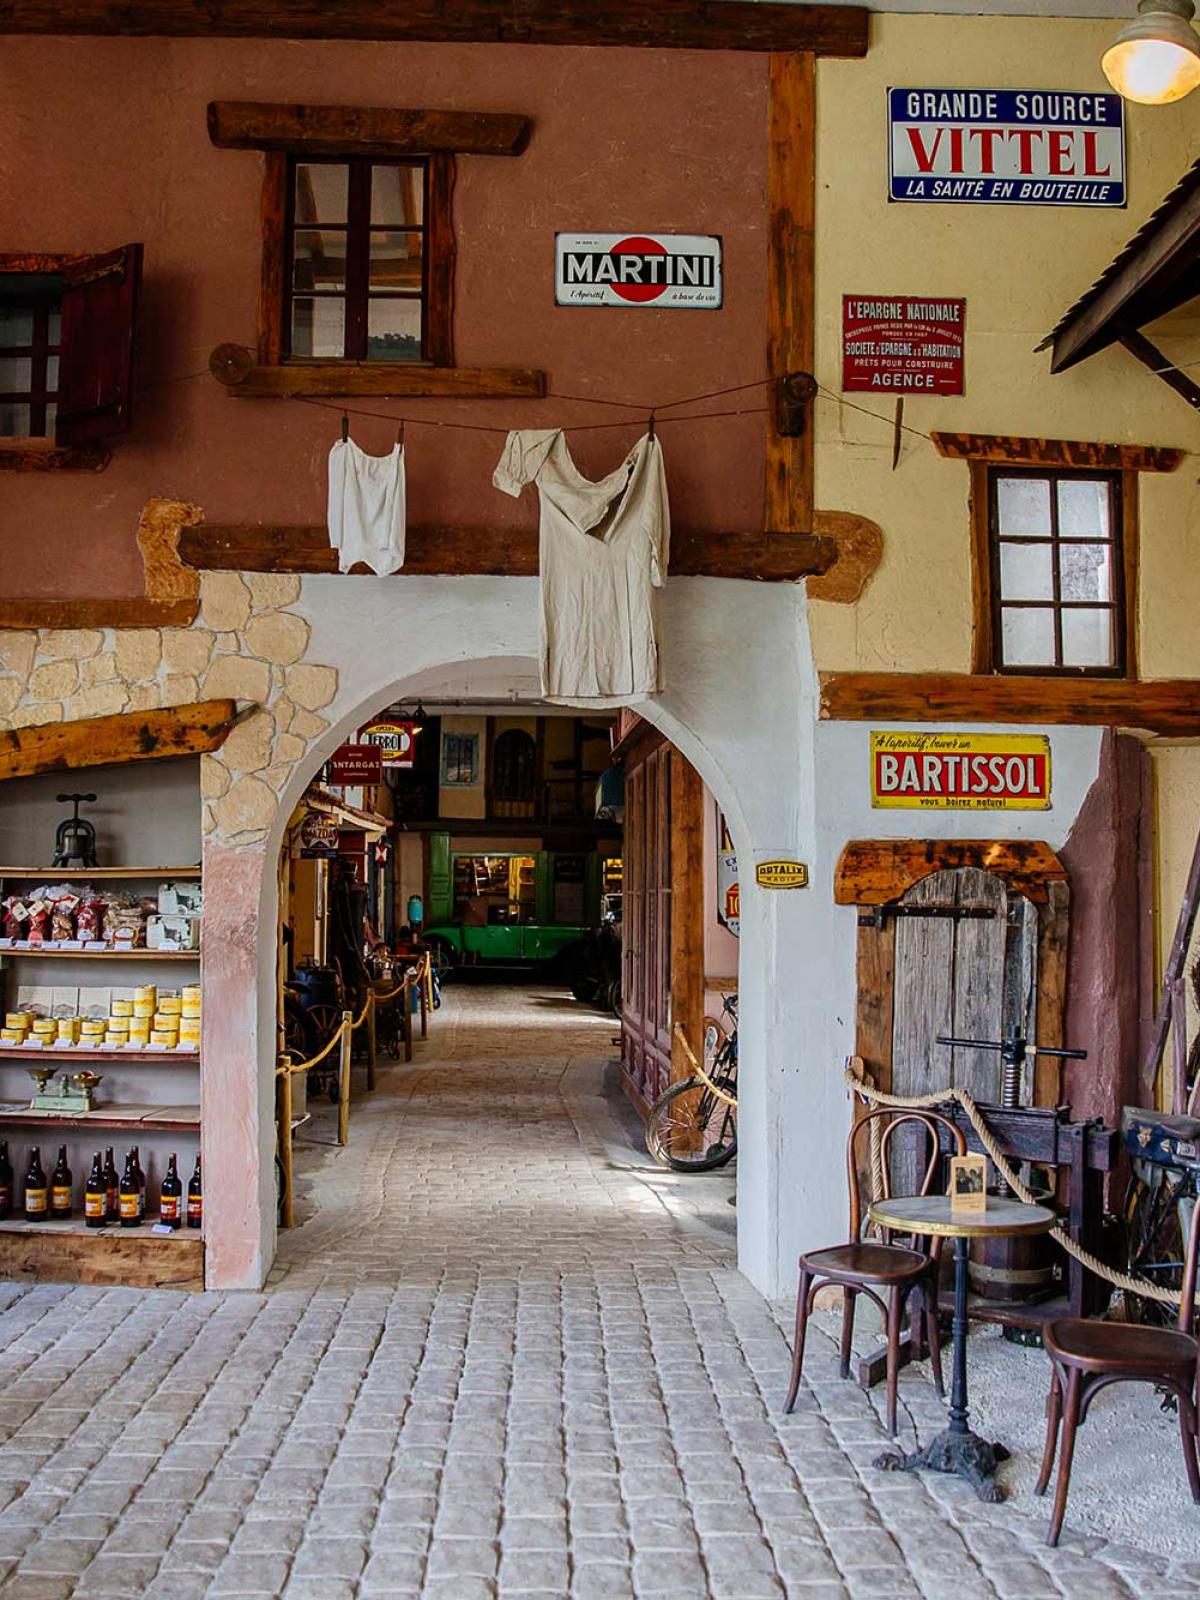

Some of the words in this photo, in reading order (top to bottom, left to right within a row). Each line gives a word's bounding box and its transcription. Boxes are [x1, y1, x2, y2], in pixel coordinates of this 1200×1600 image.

[907, 92, 998, 119] GRANDE
[1015, 94, 1107, 122] SOURCE
[905, 127, 1111, 177] VITTEL
[906, 180, 925, 196] LA
[990, 181, 1014, 198] EN
[1019, 182, 1111, 200] BOUTEILLE
[567, 254, 711, 285] MARTINI
[848, 301, 903, 320] L'EPARGNE
[907, 303, 960, 322] NATIONALE
[845, 342, 876, 355] SOCIETE
[881, 359, 902, 367] POUR
[905, 360, 954, 370] CONSTRUIRE
[872, 373, 935, 387] AGENCE
[880, 754, 1041, 794] BARTISSOL
[920, 798, 939, 806] vous
[945, 797, 971, 807] boirez
